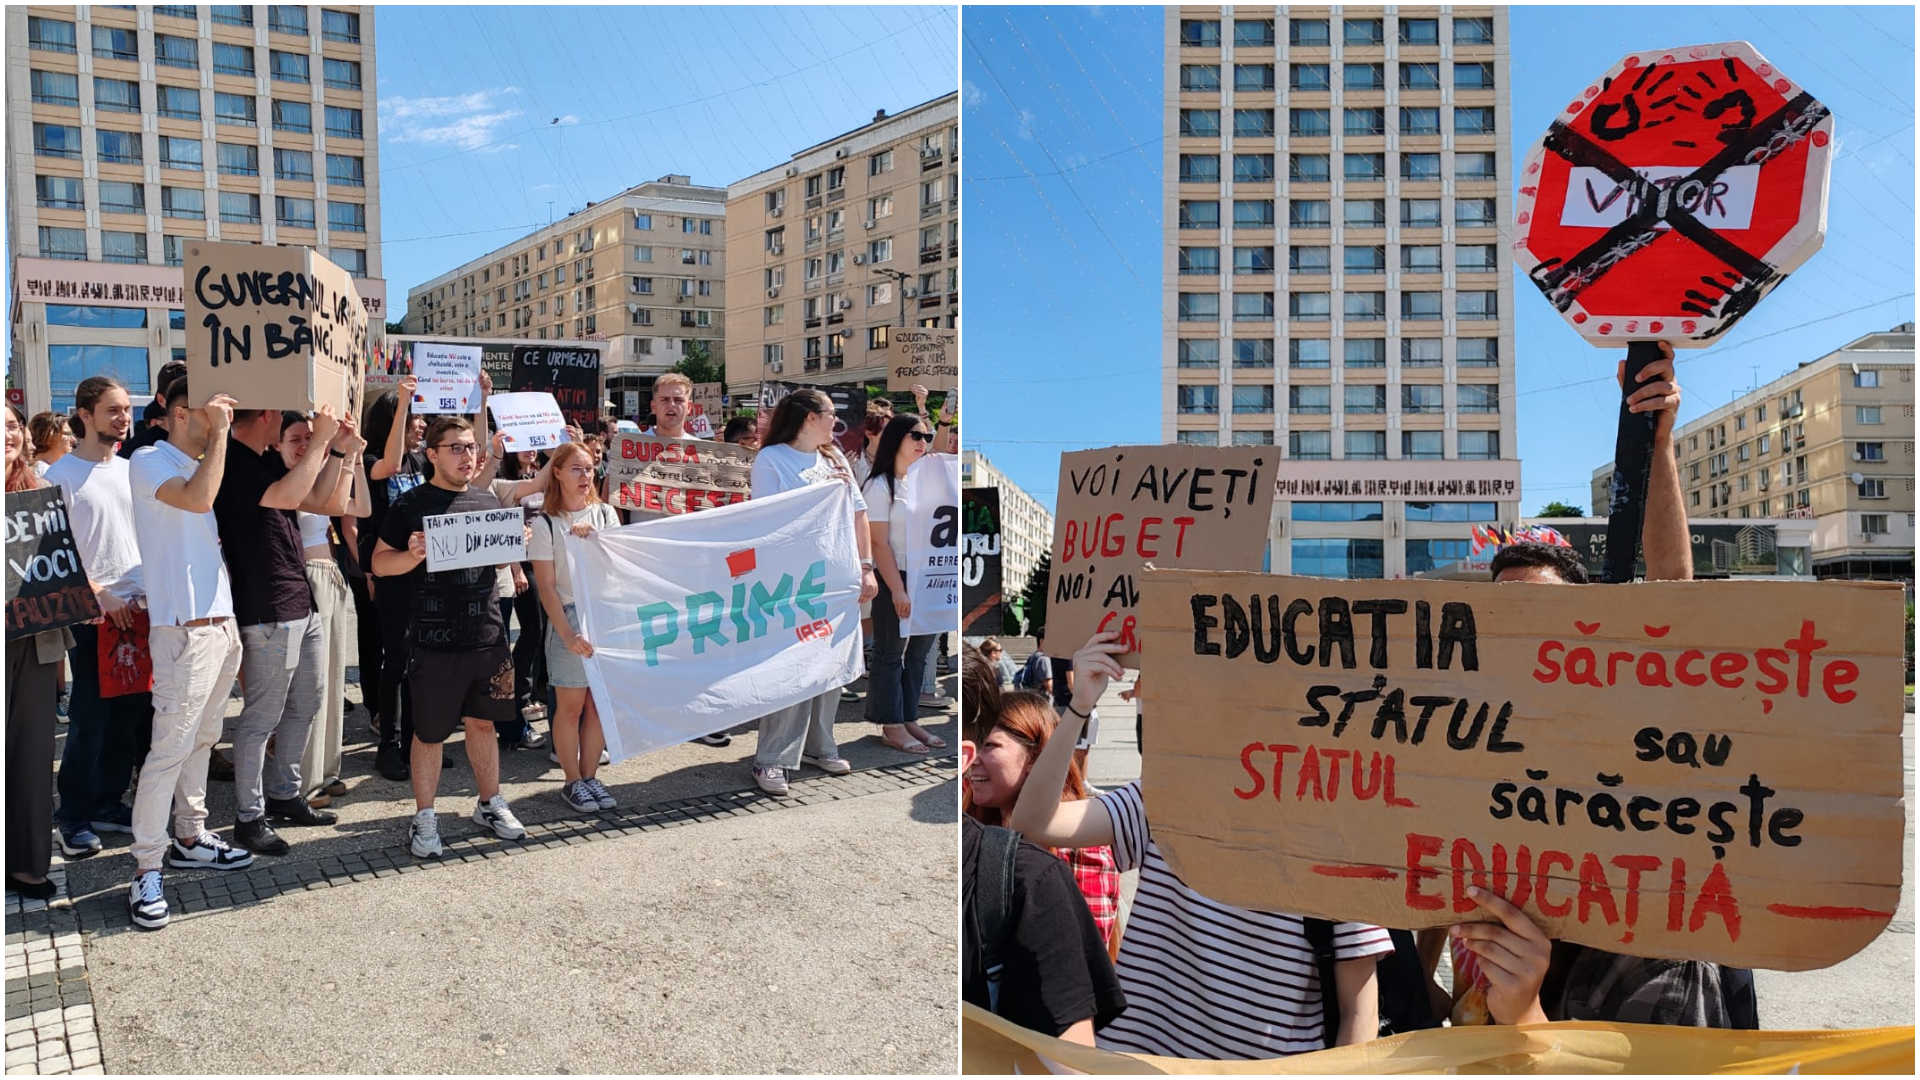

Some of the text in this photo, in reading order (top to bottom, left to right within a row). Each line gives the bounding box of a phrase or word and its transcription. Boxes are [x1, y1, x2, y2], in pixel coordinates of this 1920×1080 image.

[195, 265, 329, 320] GUVERNUL
[203, 313, 251, 367] ÎN
[523, 351, 598, 369] CE URMEAZA
[902, 344, 909, 353] O
[551, 368, 560, 385] ?
[439, 398, 456, 409] USR
[621, 439, 700, 464] BURSA
[620, 482, 752, 514] NECESA
[1070, 454, 1264, 519] VOI AVEȚI
[465, 515, 481, 525] DIN
[1062, 513, 1195, 564] BUGET
[9, 538, 78, 583] VOCI
[431, 534, 458, 560] NU
[466, 531, 481, 554] DIN
[637, 548, 827, 667] PRIME
[1055, 565, 1140, 608] NOI AV
[1532, 618, 1860, 714] sărăcește
[1297, 686, 1733, 769] STATUL sau
[1234, 741, 1805, 859] STATUL sărăcește
[1404, 832, 1742, 943] EDUCAȚIA
